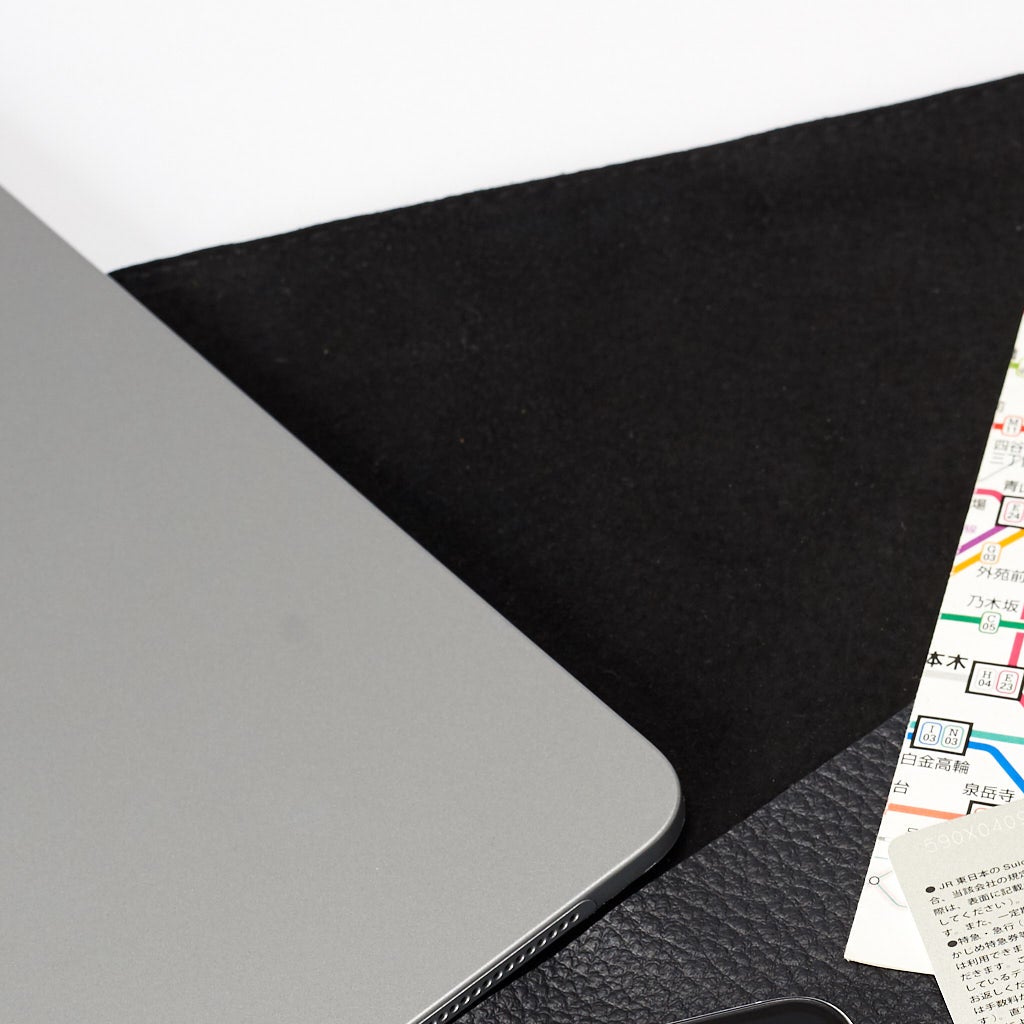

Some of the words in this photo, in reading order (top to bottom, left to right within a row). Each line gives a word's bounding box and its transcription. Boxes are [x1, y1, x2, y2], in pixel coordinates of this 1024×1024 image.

[967, 594, 1020, 613] 乃木坂
[901, 753, 971, 774] 白金高輪
[962, 783, 1015, 803] 泉岳寺
